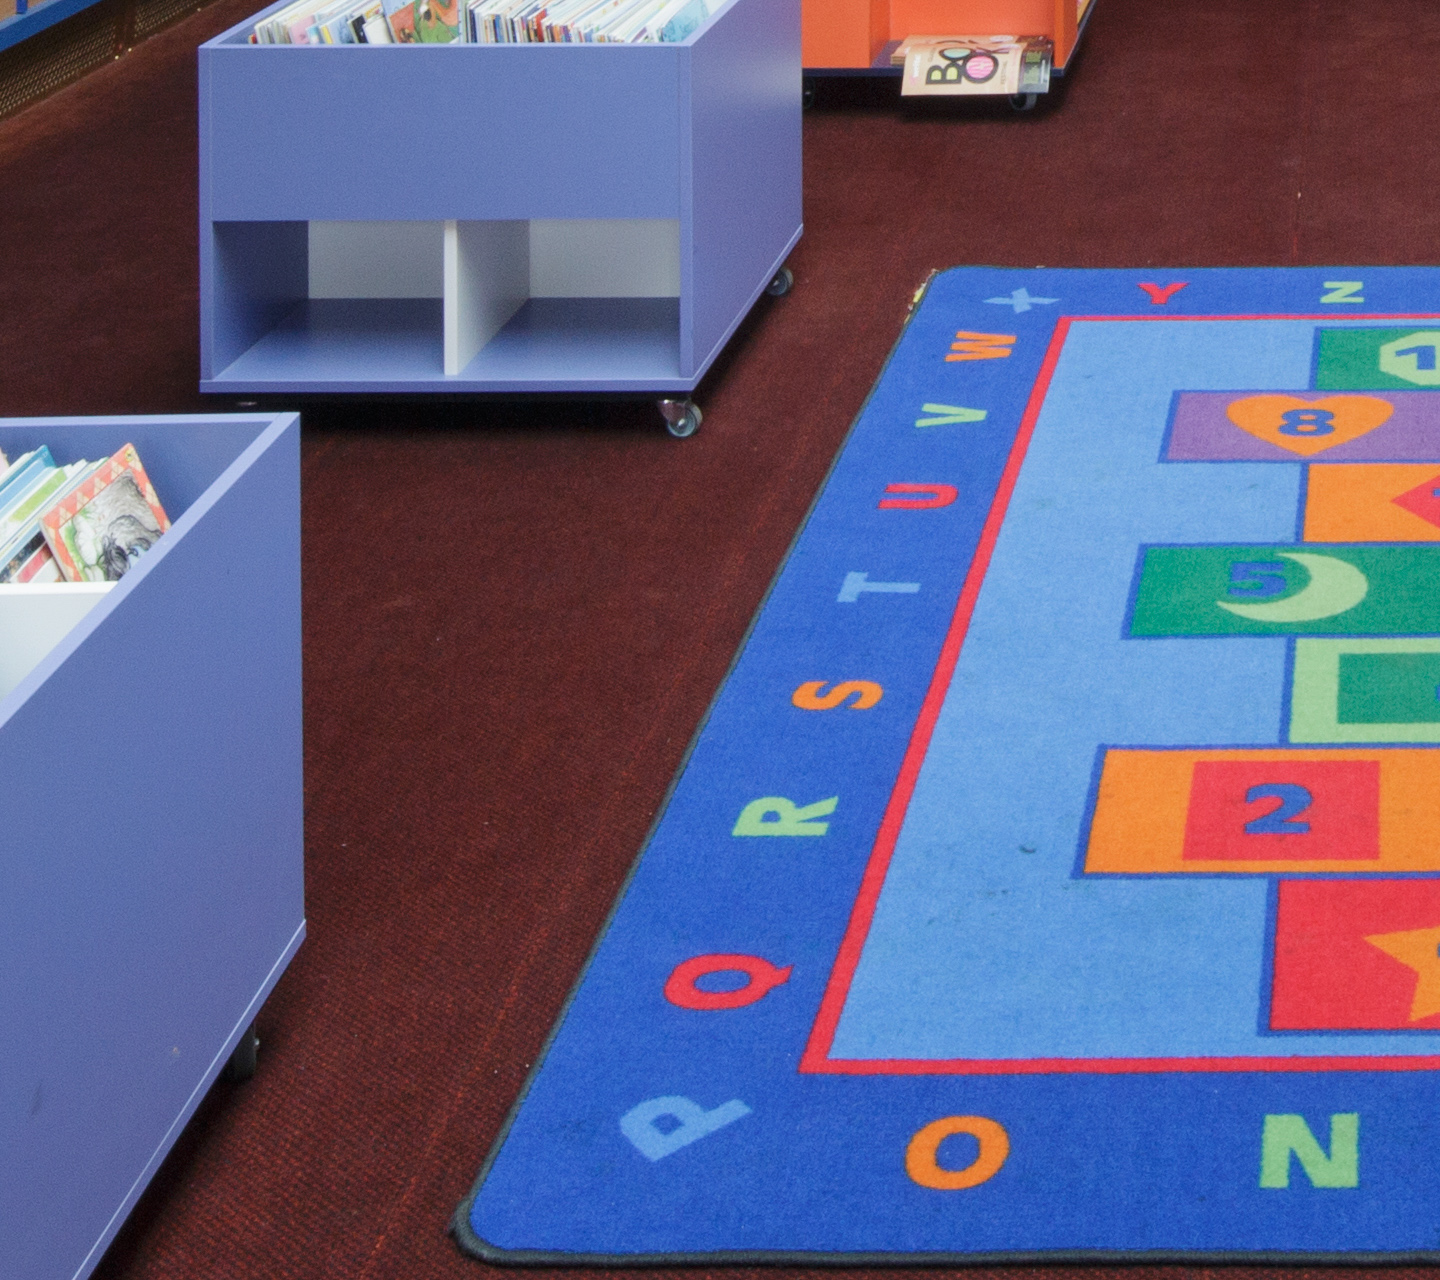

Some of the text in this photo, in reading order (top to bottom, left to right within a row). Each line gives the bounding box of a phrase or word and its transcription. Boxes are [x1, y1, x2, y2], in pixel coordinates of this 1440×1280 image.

[984, 289, 1059, 312] X
[1136, 281, 1188, 305] Y
[1319, 282, 1364, 303] Z
[946, 331, 1017, 363] W
[914, 403, 987, 428] V
[1277, 407, 1335, 438] 8
[877, 484, 957, 509] U
[827, 570, 920, 594] T
[1226, 561, 1286, 599] 5
[793, 676, 884, 714] S
[731, 794, 841, 842] R
[1242, 782, 1311, 837] 2
[664, 951, 793, 1012] Q
[617, 1092, 751, 1163] P
[904, 1113, 1010, 1191] O
[1260, 1112, 1361, 1190] N
